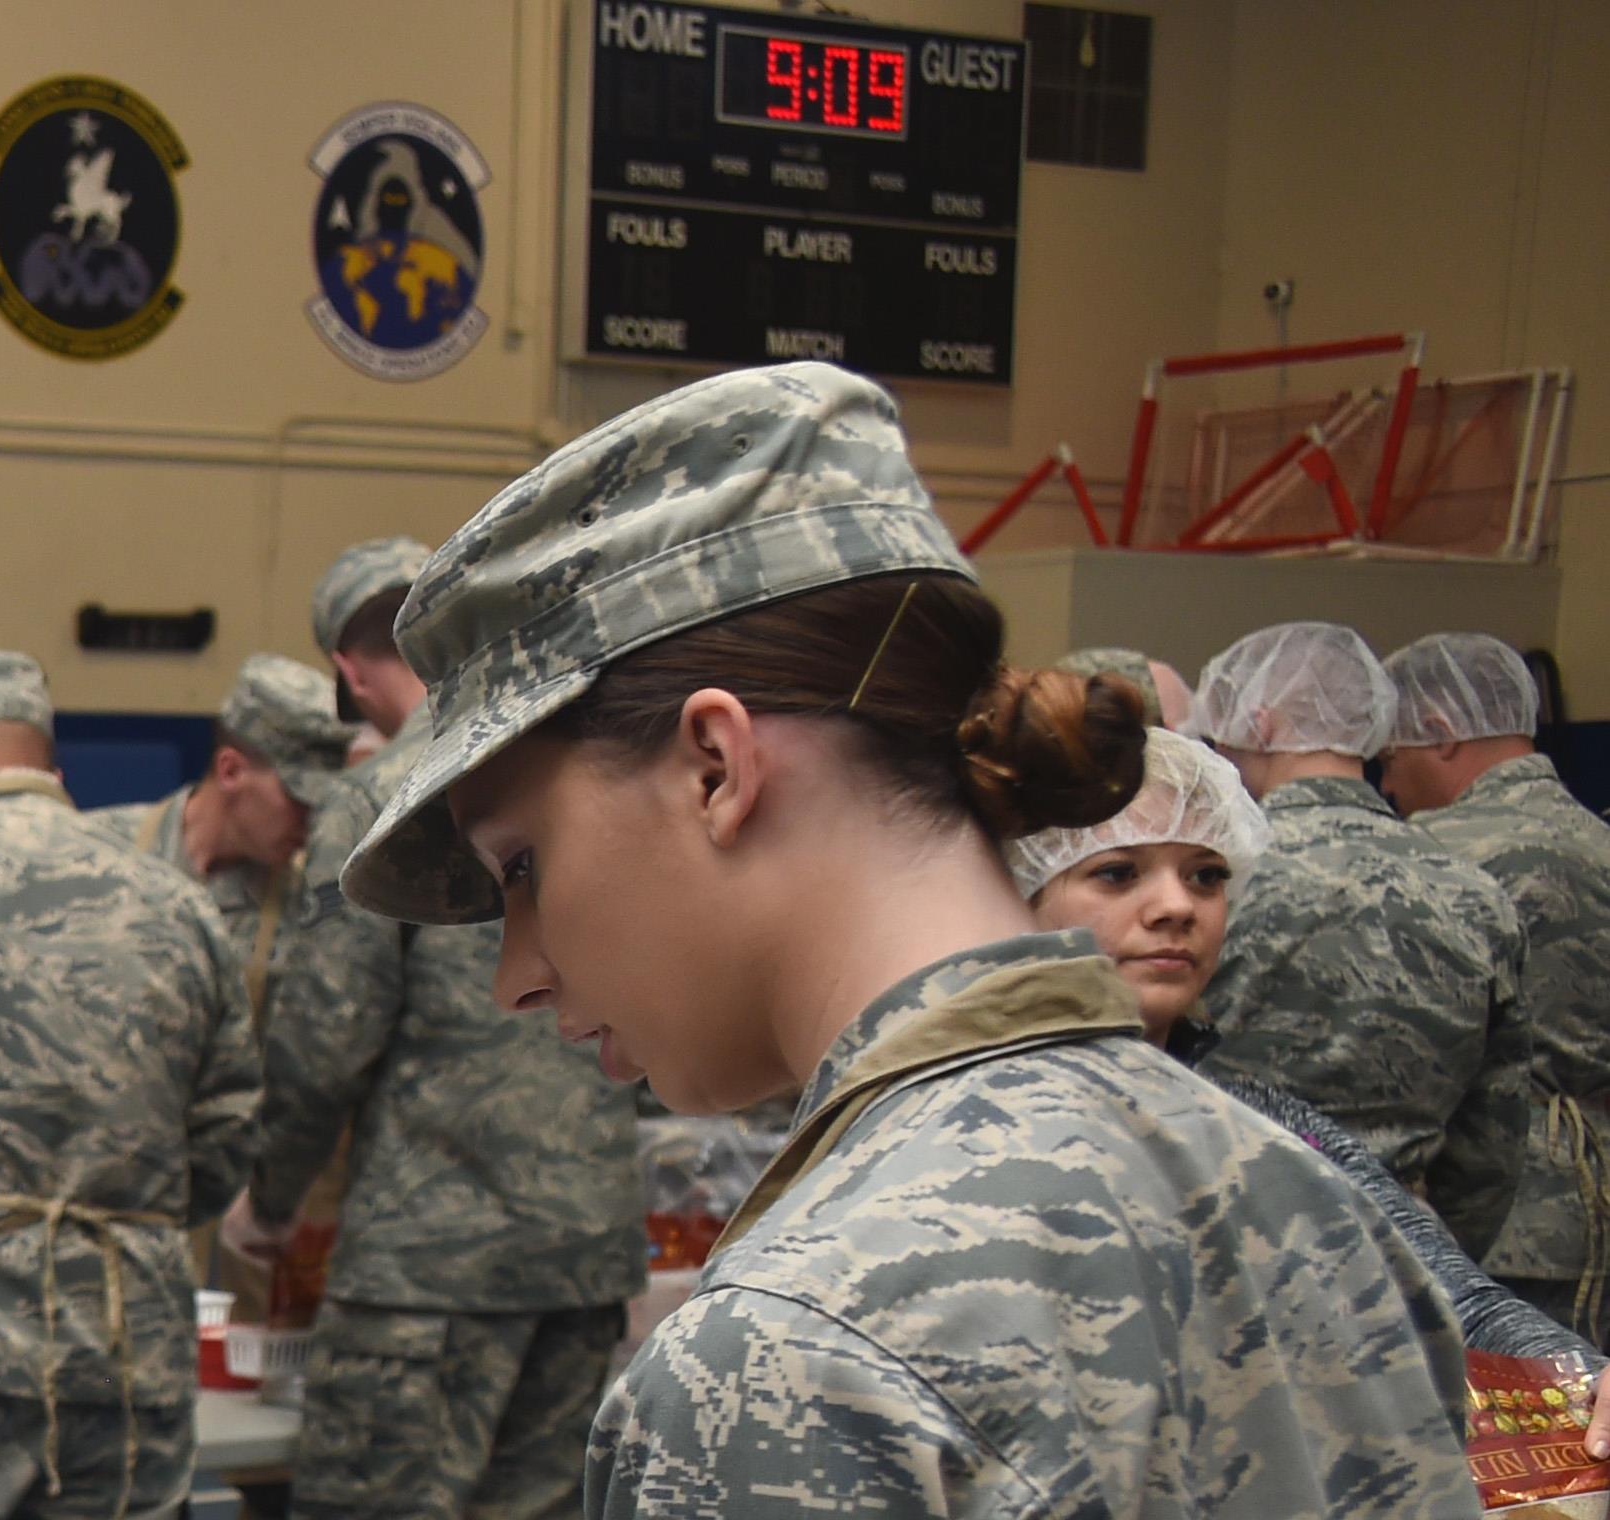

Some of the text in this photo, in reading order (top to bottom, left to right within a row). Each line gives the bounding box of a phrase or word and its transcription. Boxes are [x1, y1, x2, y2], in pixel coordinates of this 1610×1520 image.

[599, 7, 707, 57] HOME
[921, 41, 1018, 92] GUEST
[766, 38, 904, 132] 9:09
[625, 160, 685, 189] BONUS
[771, 161, 828, 191] PERIOD
[931, 192, 984, 218] BONUS
[607, 213, 687, 249] FOULS
[763, 227, 853, 264] PLAYER
[925, 243, 997, 276] FOULS
[603, 315, 687, 351] SCORE
[766, 328, 844, 361] MATCH
[920, 341, 995, 373] SCORE
